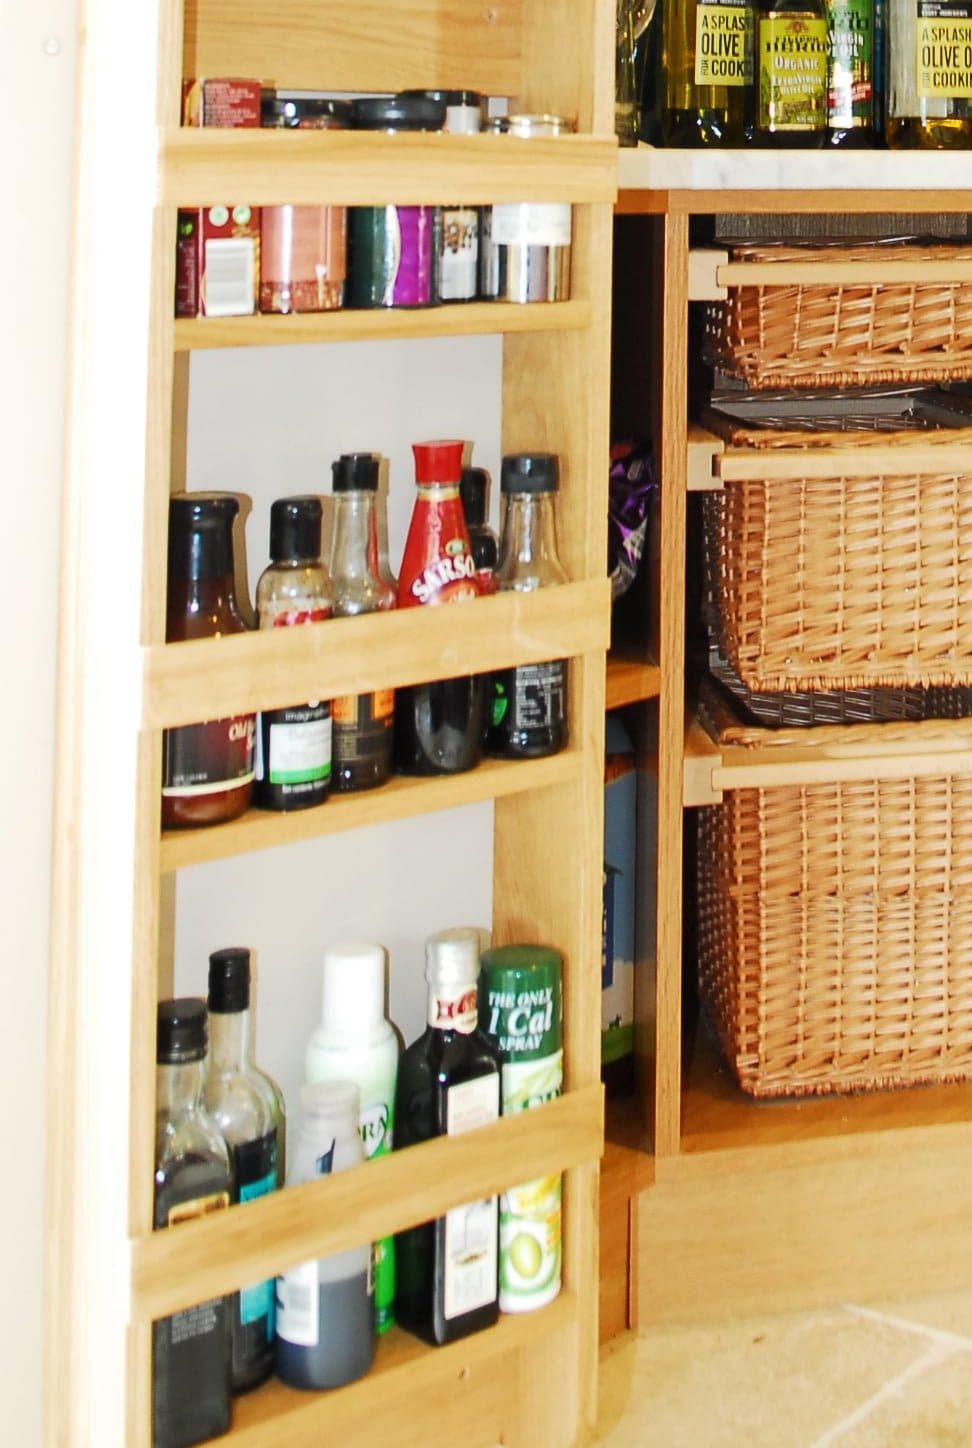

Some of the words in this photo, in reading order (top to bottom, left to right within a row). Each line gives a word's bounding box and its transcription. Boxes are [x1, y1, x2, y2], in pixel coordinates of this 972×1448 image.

[702, 15, 709, 29] A
[711, 15, 745, 31] SPLAS
[701, 34, 740, 57] OLIVE
[922, 28, 929, 42] A
[931, 28, 972, 43] SPLASH
[711, 59, 745, 77] COOK
[922, 45, 960, 68] OLIVE
[411, 554, 476, 603] SARSO
[488, 990, 514, 1009] THE
[516, 986, 553, 1007] ONLY
[507, 999, 553, 1037] Cal
[498, 1034, 543, 1051] SPRAY
